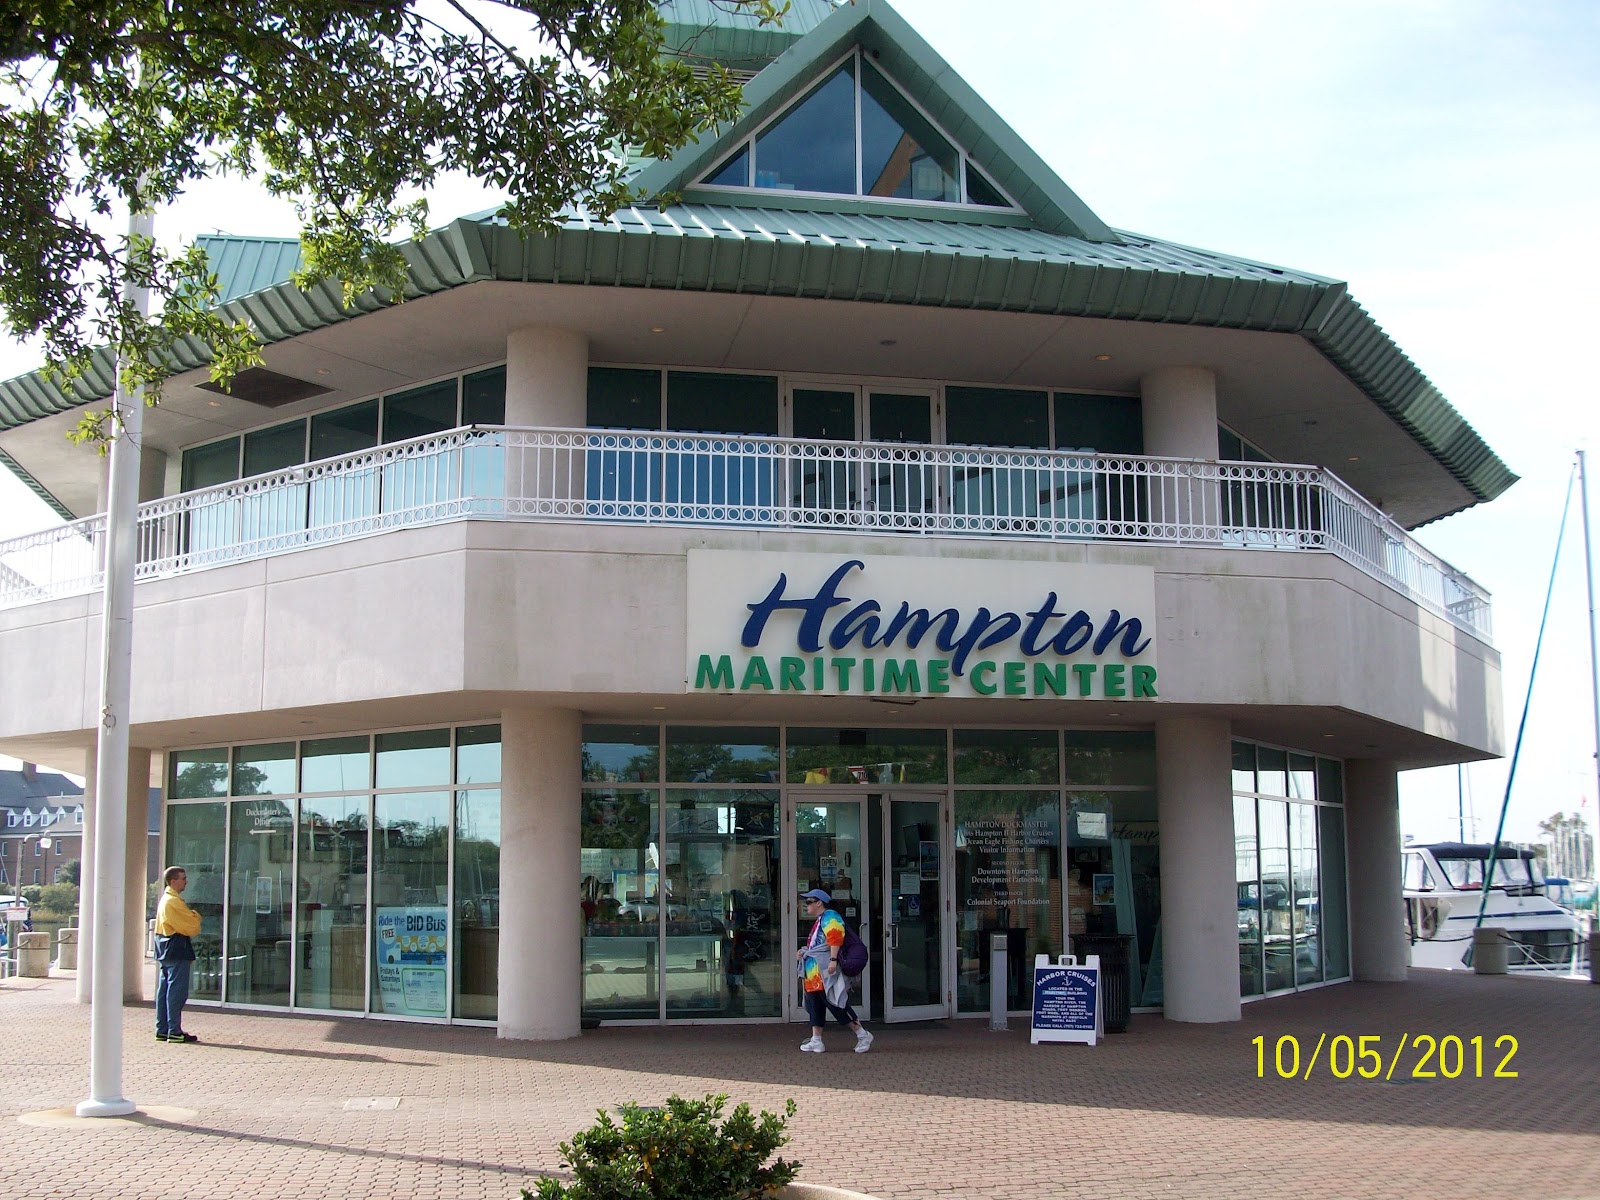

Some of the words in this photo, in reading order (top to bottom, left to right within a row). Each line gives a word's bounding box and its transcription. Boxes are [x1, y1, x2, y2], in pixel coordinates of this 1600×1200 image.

[741, 560, 1152, 677] Hampton
[694, 654, 949, 693] MARITIME
[969, 660, 1159, 697] CENTER
[975, 829, 1003, 838] Hampton
[1010, 829, 1031, 837] Harbor
[1032, 829, 1054, 837] Cruises
[984, 838, 1001, 847] Eagle
[1001, 838, 1024, 847] Fishing
[821, 858, 837, 866] OPEN
[1012, 868, 1039, 876] Hampton
[971, 876, 1012, 885] Development
[1012, 876, 1045, 885] Partnership
[967, 898, 993, 906] Colonial
[993, 898, 1016, 907] Seaport
[378, 915, 393, 926] Ride
[394, 915, 405, 926] the
[406, 915, 424, 931] BID
[426, 915, 446, 931] Bus
[381, 928, 394, 939] FREE
[380, 966, 395, 975] Fridays
[1036, 970, 1066, 986] HARBOR
[1066, 970, 1096, 988] CRUISES
